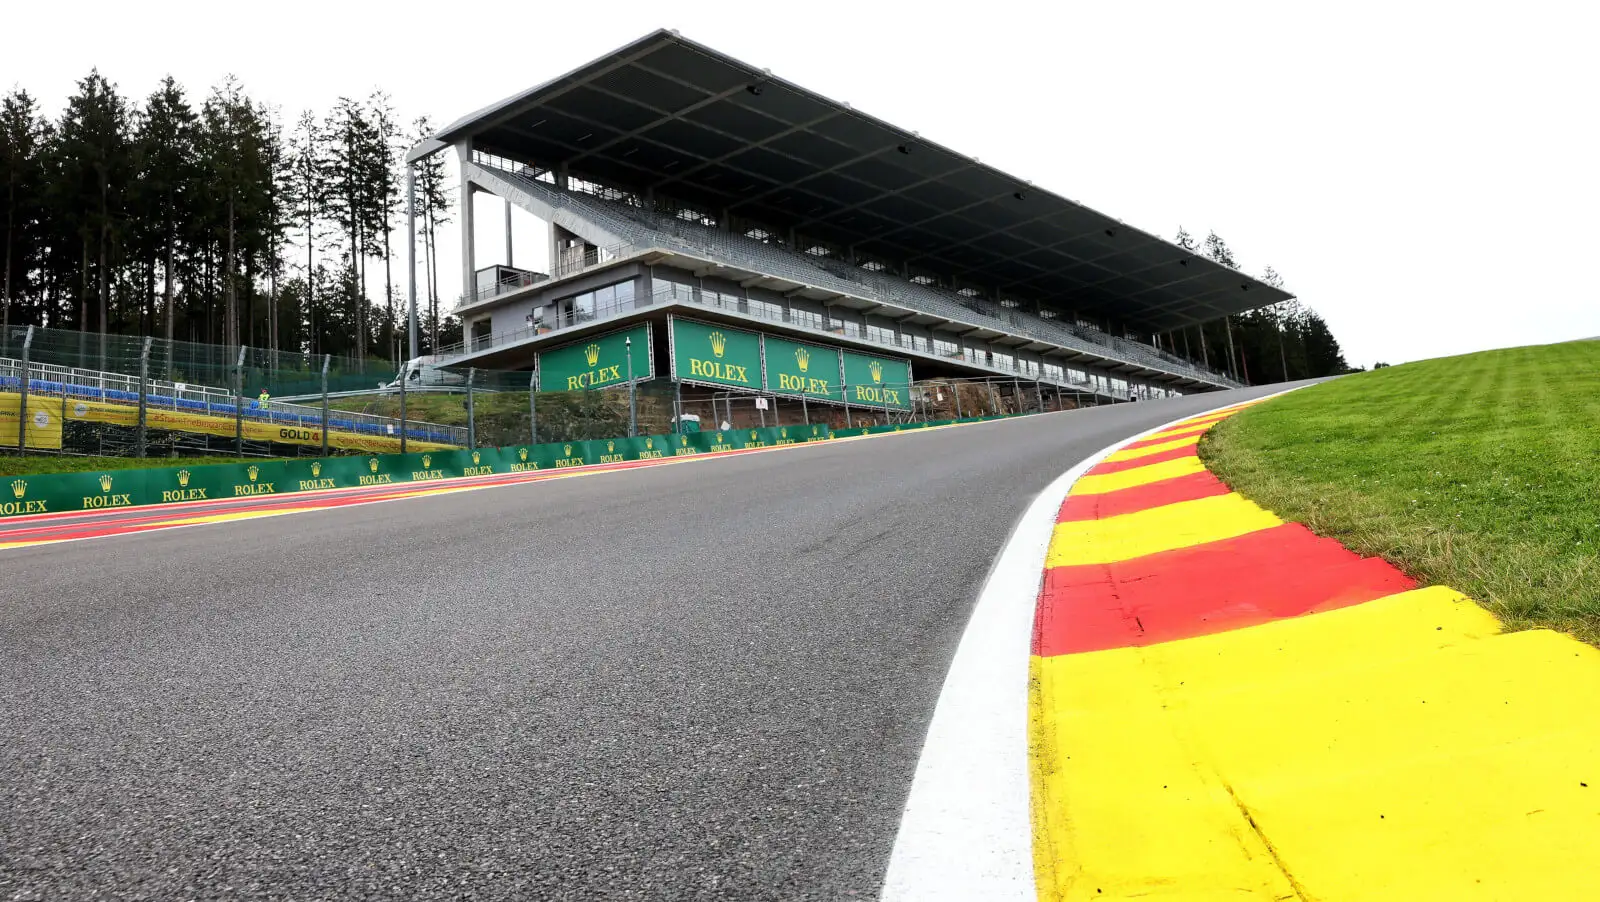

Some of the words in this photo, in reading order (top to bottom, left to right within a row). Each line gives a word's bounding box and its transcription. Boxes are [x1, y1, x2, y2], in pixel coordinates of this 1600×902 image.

[690, 358, 749, 383] ROLEX
[778, 373, 829, 395] ROLEX
[855, 385, 900, 405] ROLEX
[279, 428, 310, 441] GOLD
[312, 432, 320, 442] 4
[676, 447, 696, 456] ROLEX
[711, 443, 732, 453] ROLEX
[600, 453, 624, 464] ROLEX
[639, 449, 662, 460] ROLEX
[510, 461, 539, 472] ROLEX
[555, 457, 584, 469] ROLEX
[412, 469, 444, 481] ROLEX
[463, 465, 493, 477] ROLEX
[299, 478, 336, 490] ROLEX
[359, 473, 392, 486] ROLEX
[162, 488, 207, 502] ROLEX
[234, 483, 275, 496] ROLEX
[83, 494, 131, 509] ROLEX
